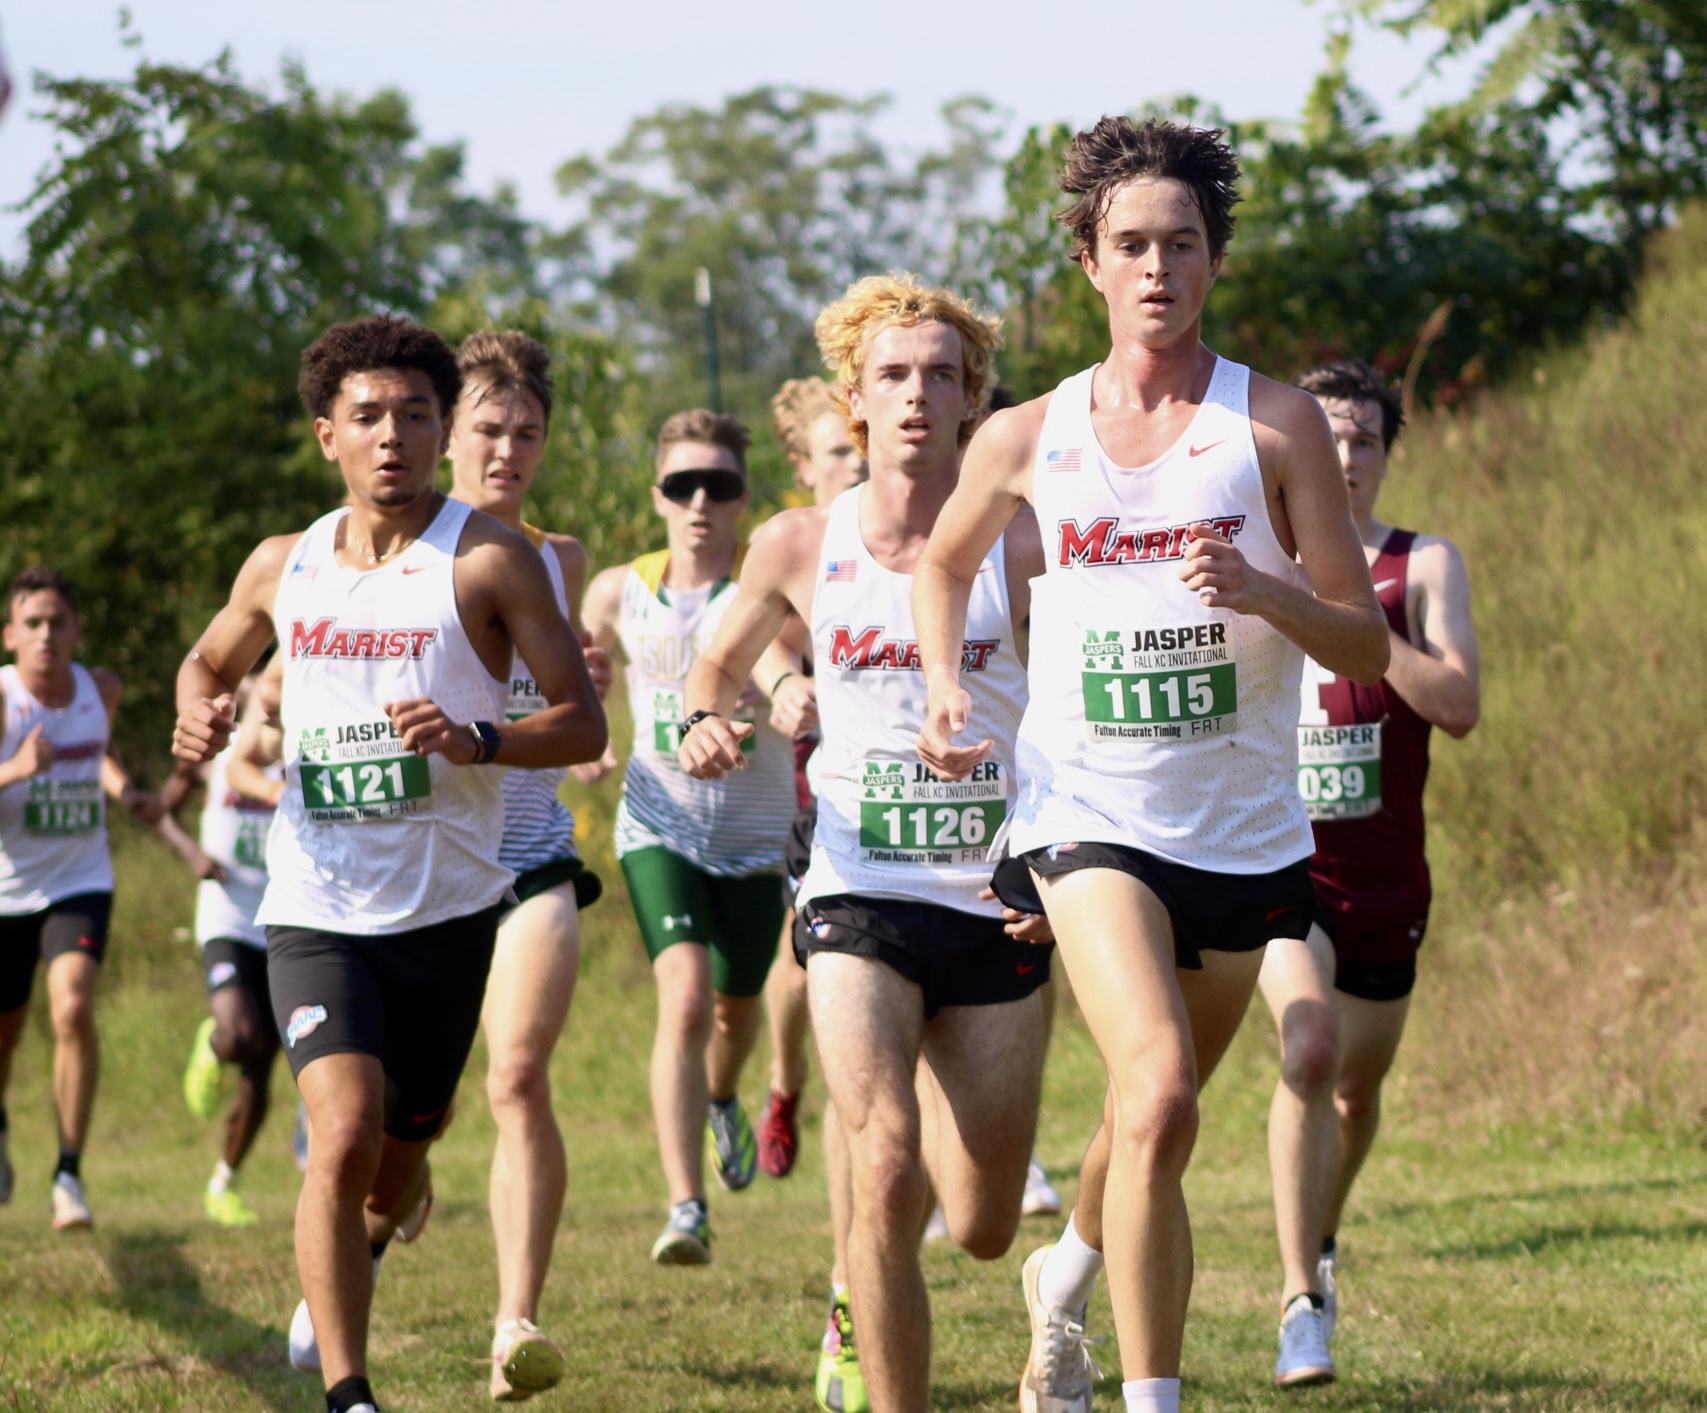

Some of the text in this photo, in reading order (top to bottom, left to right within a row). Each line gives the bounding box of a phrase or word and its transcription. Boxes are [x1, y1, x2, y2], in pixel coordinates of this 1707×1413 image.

[290, 617, 438, 661] MARIST
[1131, 622, 1226, 651] JASPER
[829, 625, 1001, 672] MART
[1085, 644, 1122, 655] JASPERS
[1134, 647, 1228, 668] FALL XC INVITATIONAL
[1104, 674, 1214, 719] 1115
[336, 721, 398, 744] JASPE
[1094, 717, 1222, 739] Fulton Accurate Timing FAT
[1302, 727, 1374, 746] JASPER
[339, 747, 354, 759] FALL
[355, 746, 365, 758] XC
[317, 761, 405, 805] 1121
[865, 775, 903, 785] JASPERS
[1298, 765, 1365, 801] 039
[914, 784, 1000, 799] FALL XC INVITATIONAL
[883, 807, 986, 846] 1126
[869, 850, 892, 862] Fulton
[893, 851, 926, 862] Accurate
[927, 851, 952, 863] Timing
